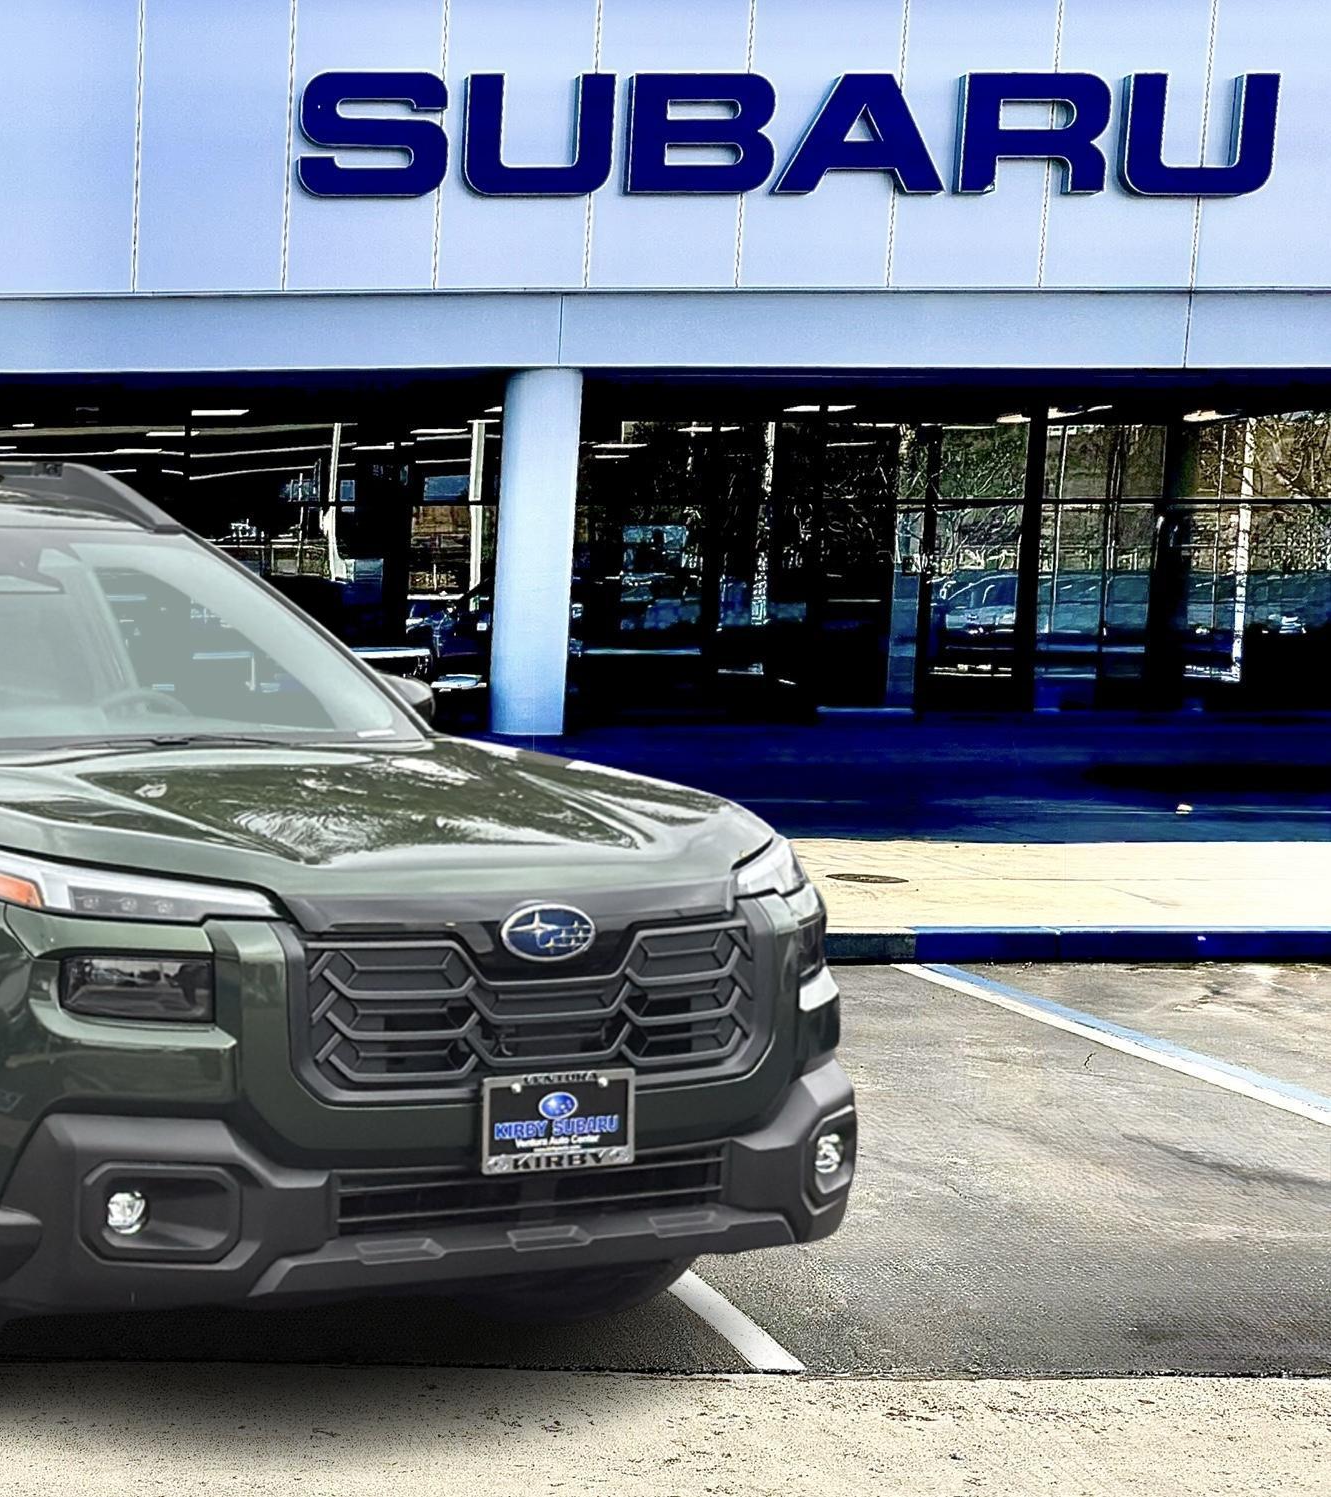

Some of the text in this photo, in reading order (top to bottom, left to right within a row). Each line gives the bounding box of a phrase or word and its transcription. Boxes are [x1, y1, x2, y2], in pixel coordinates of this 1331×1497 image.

[296, 71, 1283, 197] SUBARU
[523, 1072, 598, 1085] VENTURA
[494, 1115, 619, 1140] KIRBY SUBARU
[515, 1138, 548, 1148] Ventura
[549, 1136, 569, 1146] Auto
[571, 1134, 600, 1144] Center
[513, 1152, 606, 1169] KIRBY
